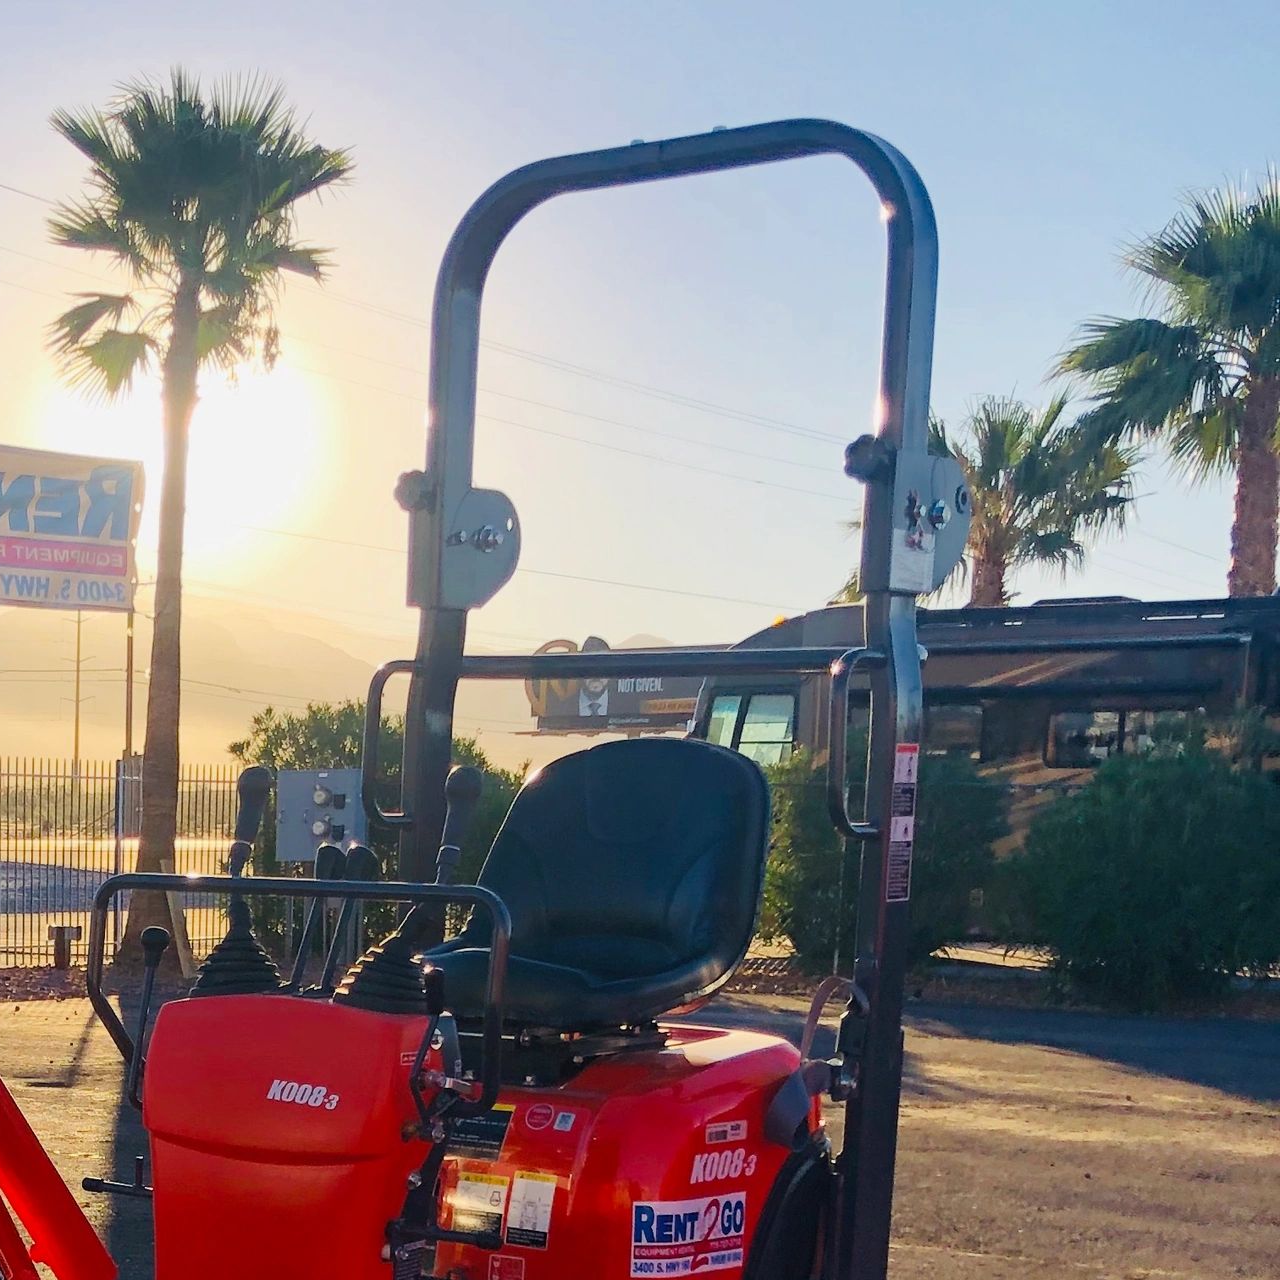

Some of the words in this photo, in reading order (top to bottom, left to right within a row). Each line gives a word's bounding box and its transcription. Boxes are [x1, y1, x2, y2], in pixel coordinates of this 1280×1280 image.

[618, 678, 635, 693] NOT
[266, 1079, 339, 1110] K008-3
[690, 1148, 757, 1184] K008-3
[634, 1205, 699, 1242] RENT
[690, 1198, 720, 1272] 2
[721, 1200, 743, 1235] GO
[633, 1262, 655, 1273] 3400
